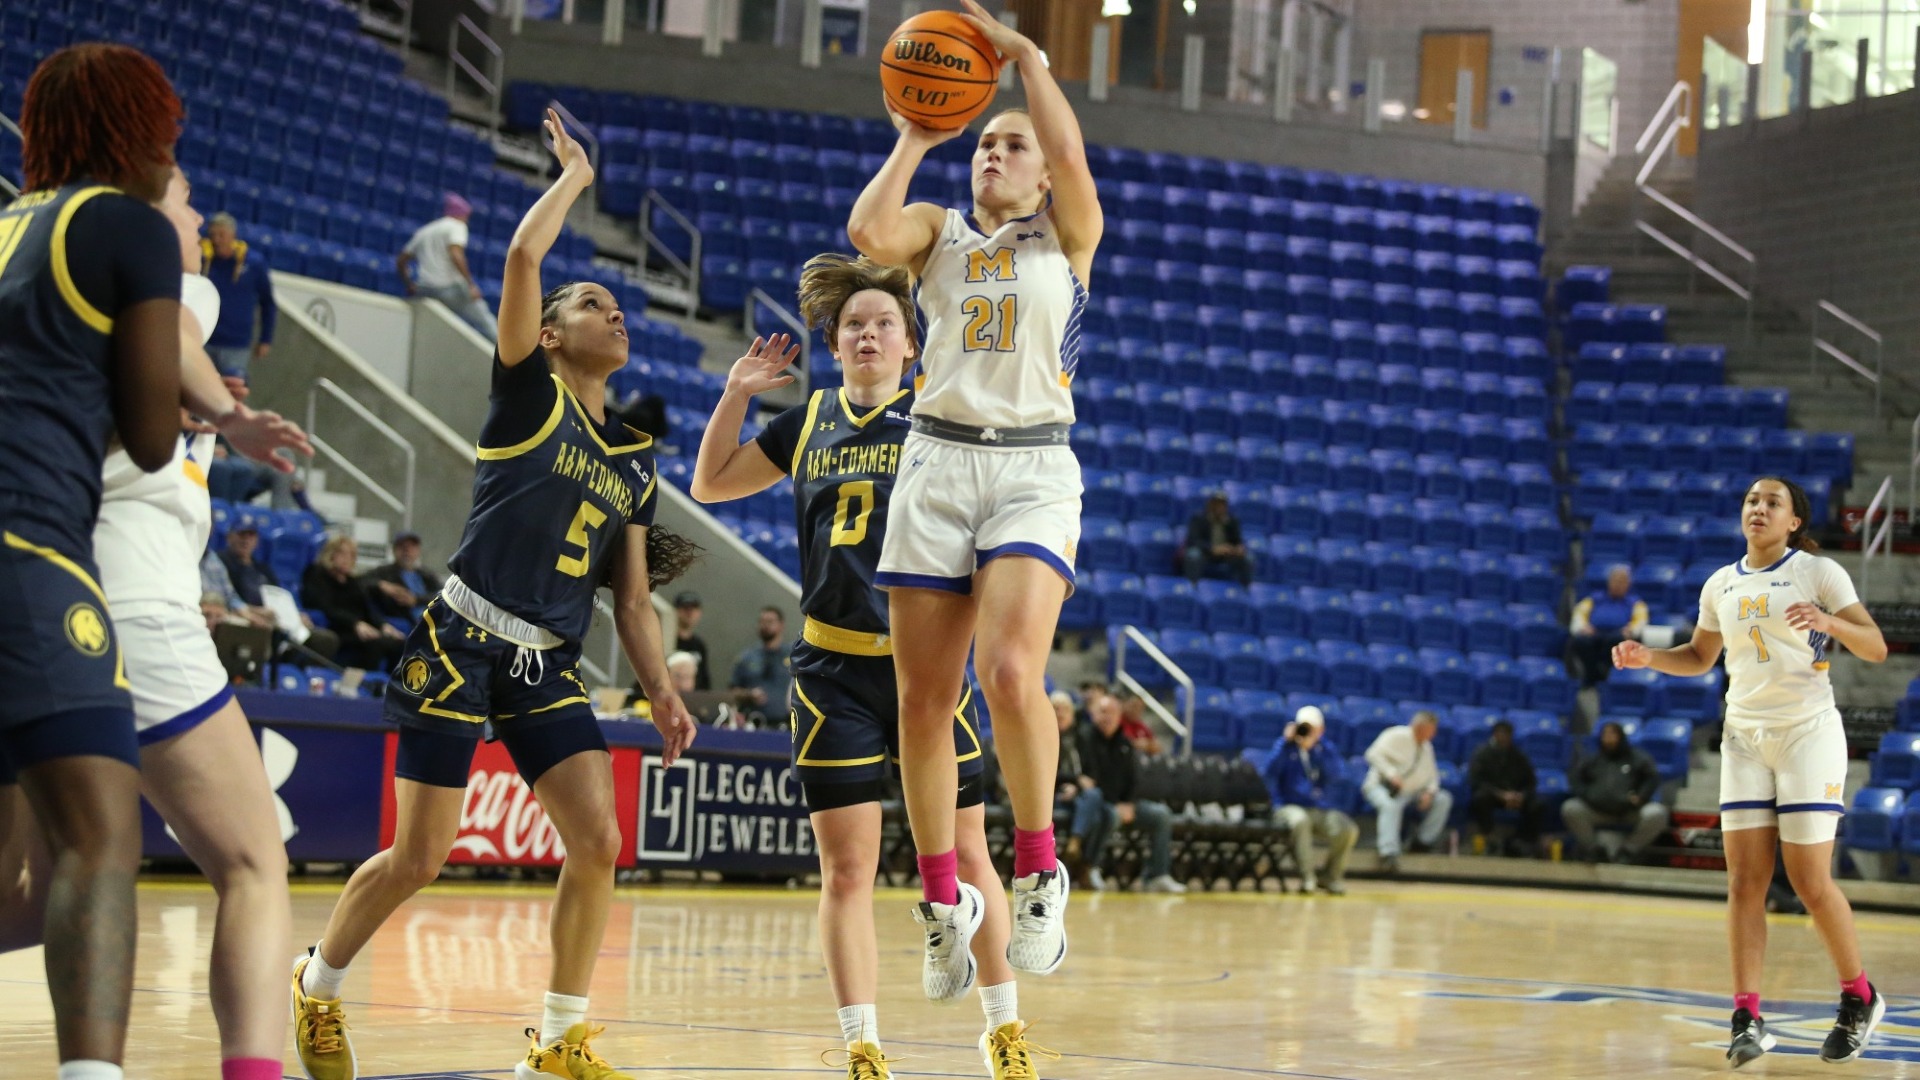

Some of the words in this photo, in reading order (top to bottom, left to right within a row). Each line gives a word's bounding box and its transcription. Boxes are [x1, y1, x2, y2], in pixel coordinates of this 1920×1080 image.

[895, 39, 971, 74] Wilson
[901, 85, 949, 106] EVO
[964, 246, 1018, 283] M
[961, 293, 1018, 352] 21
[806, 443, 906, 482] A&M-COMMER
[830, 480, 874, 547] 0
[555, 500, 607, 578] 5
[1738, 593, 1770, 620] M
[1749, 625, 1770, 663] 1
[697, 762, 809, 807] LEGAC
[1824, 782, 1841, 800] M
[694, 813, 820, 861] JEWELE
